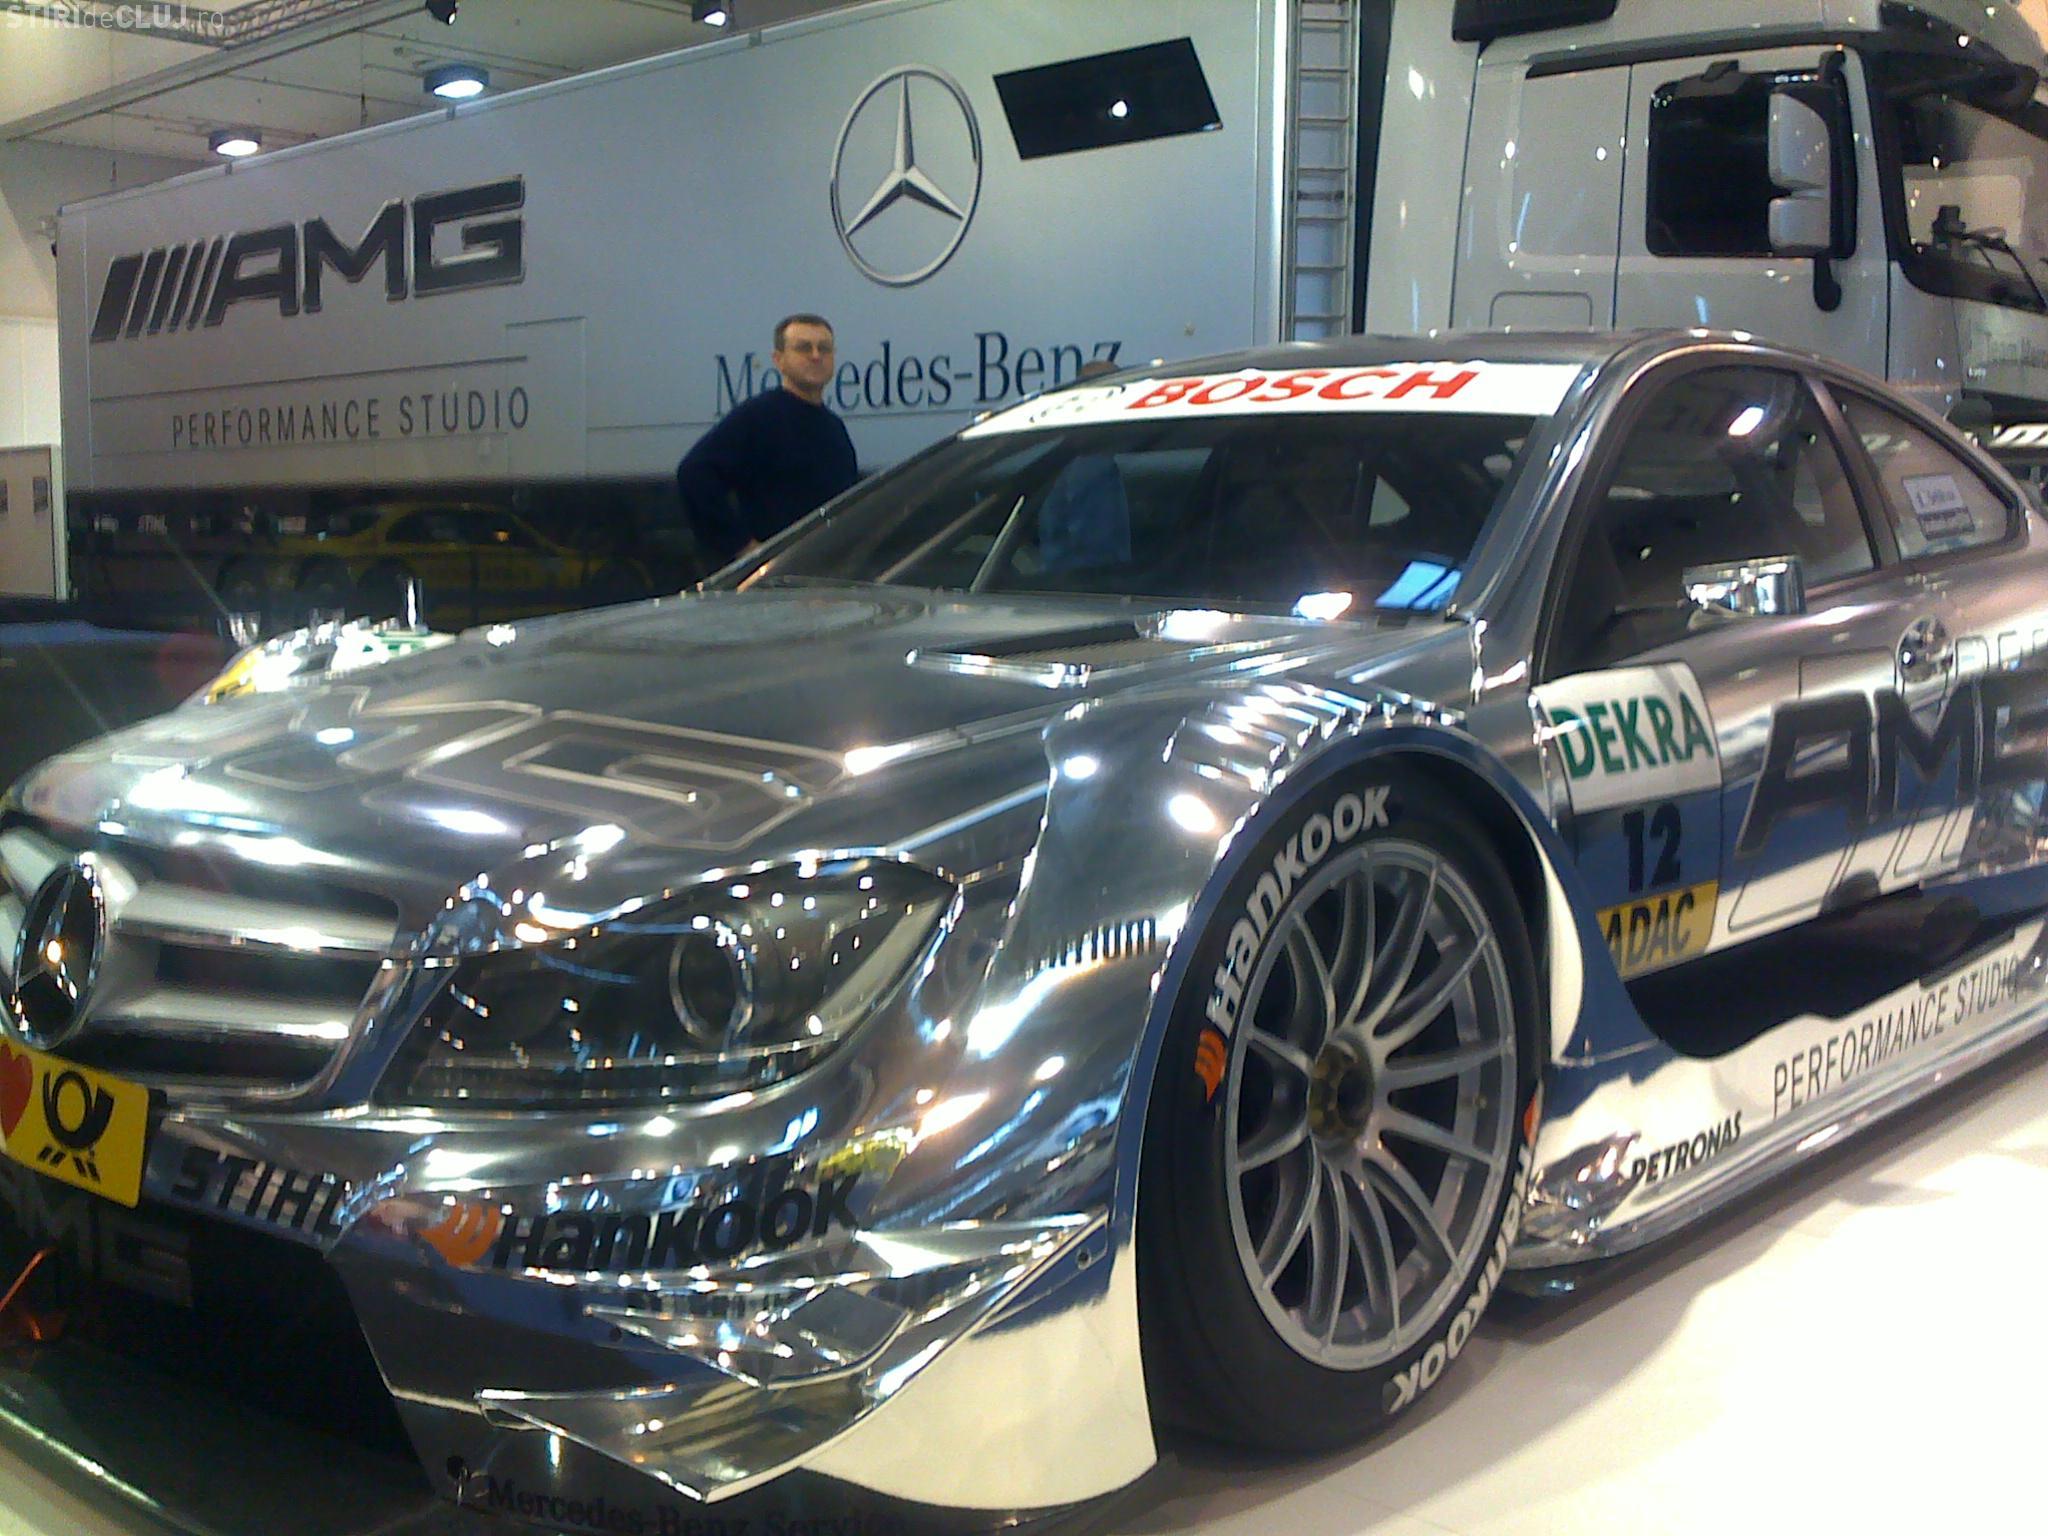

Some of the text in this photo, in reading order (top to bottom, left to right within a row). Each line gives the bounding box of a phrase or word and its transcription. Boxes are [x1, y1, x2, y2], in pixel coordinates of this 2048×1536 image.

[172, 386, 530, 448] PERFORMANCE STUDIO
[1124, 370, 1482, 411] BOSCH
[1550, 692, 1715, 780] DEKRA
[1622, 802, 1682, 894] 12
[1205, 785, 1392, 1040] Hankook
[1605, 891, 1695, 966] ADAC
[1773, 952, 2019, 1120] PERFORMANCE STUDIO
[170, 1145, 348, 1238] STIHL
[1630, 1109, 1742, 1184] PETRONAS
[494, 1172, 862, 1268] Hankook
